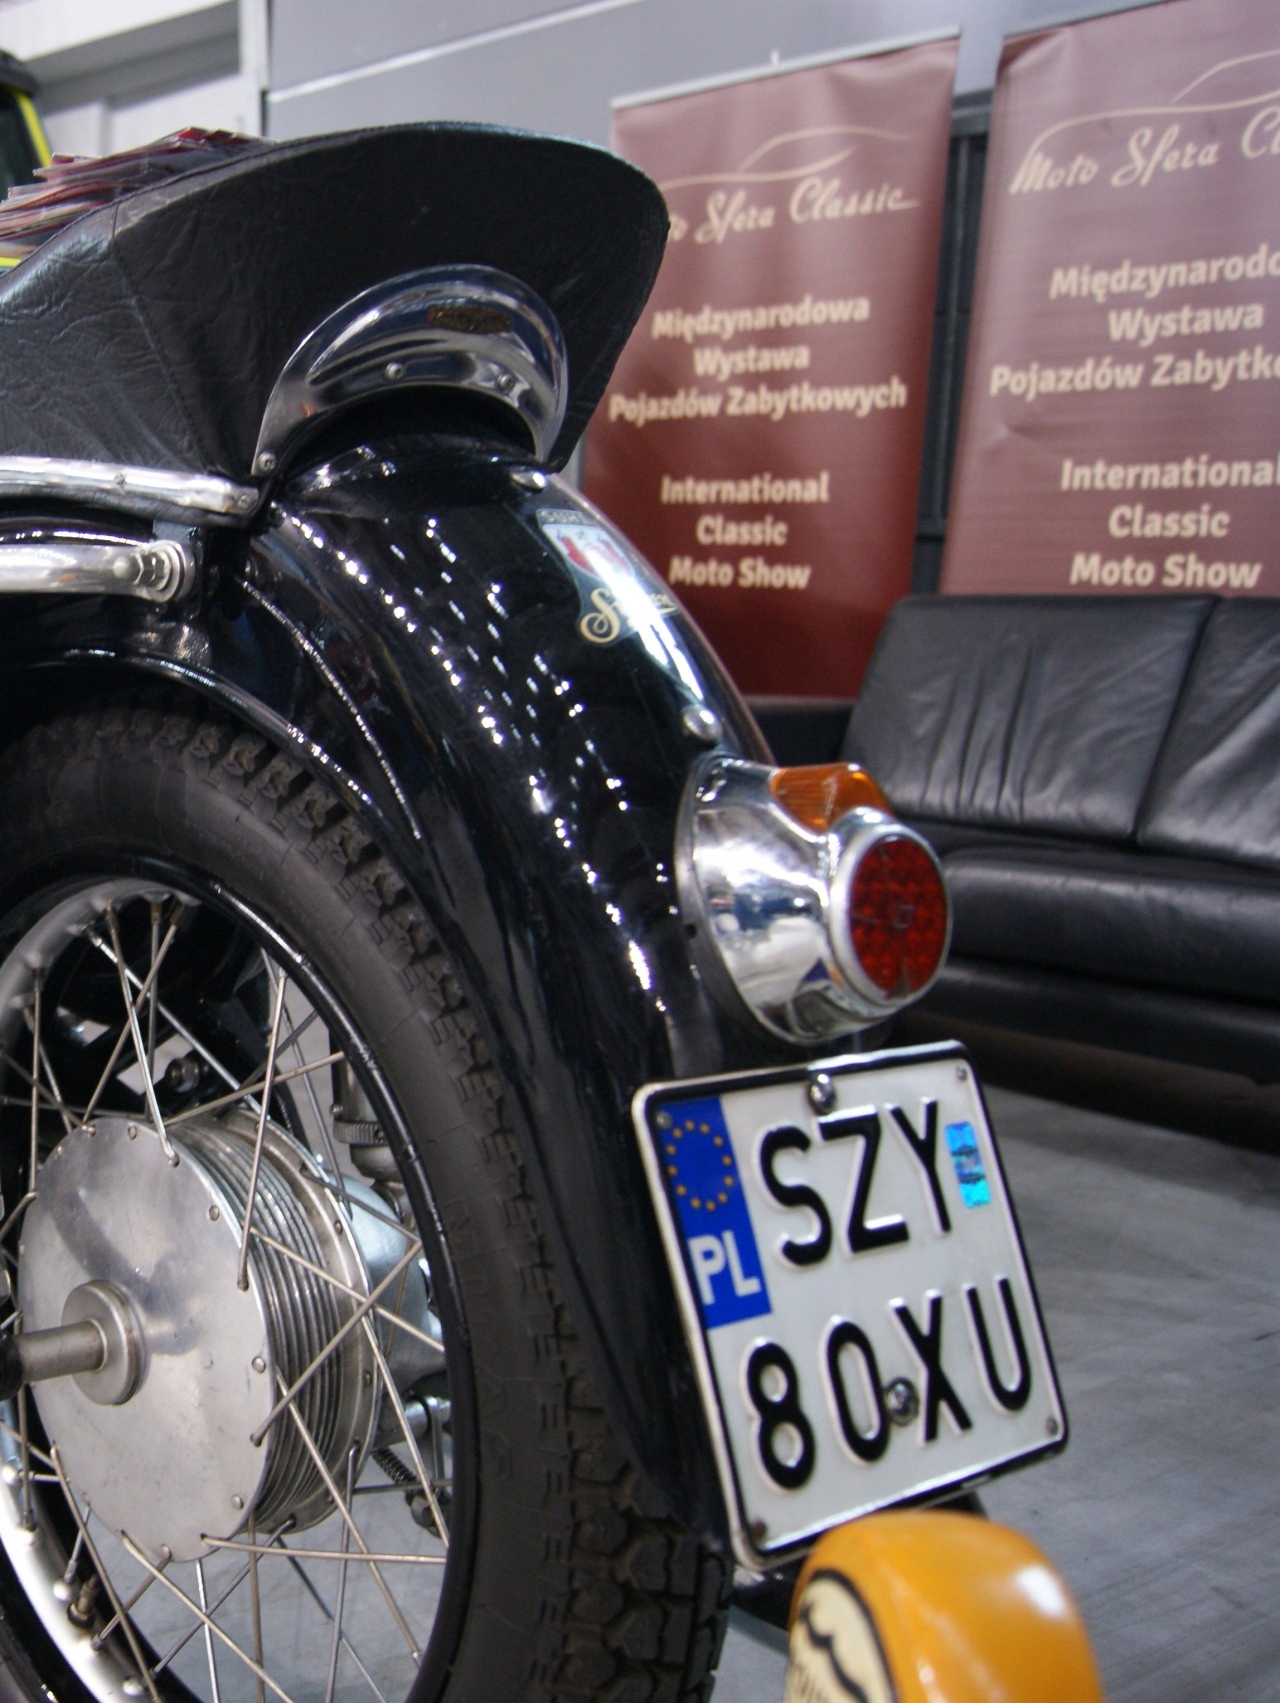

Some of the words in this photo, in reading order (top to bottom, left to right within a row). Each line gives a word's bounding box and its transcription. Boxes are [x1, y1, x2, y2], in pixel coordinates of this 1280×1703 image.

[1009, 151, 1099, 195] Moto
[1111, 123, 1220, 188] Sfera
[694, 190, 775, 245] Sfera
[789, 177, 918, 224] Classic
[651, 294, 870, 343] Międzynarodowa
[1108, 303, 1264, 348] Wystawa
[693, 346, 810, 382] Wystawa
[990, 356, 1144, 402] Pojazdów
[608, 386, 721, 428] Pojazdów
[726, 374, 908, 421] Zabytkowych
[660, 471, 829, 504] International
[1060, 451, 1280, 491] International
[696, 515, 788, 546] Classic
[1108, 502, 1230, 538] Classic
[669, 555, 734, 587] Moto
[738, 556, 811, 589] Show
[1070, 552, 1155, 586] Moto
[1161, 552, 1263, 589] Show
[753, 1095, 954, 1267] SZY
[687, 1229, 762, 1306] PL
[741, 1275, 1032, 1492] 80XU
